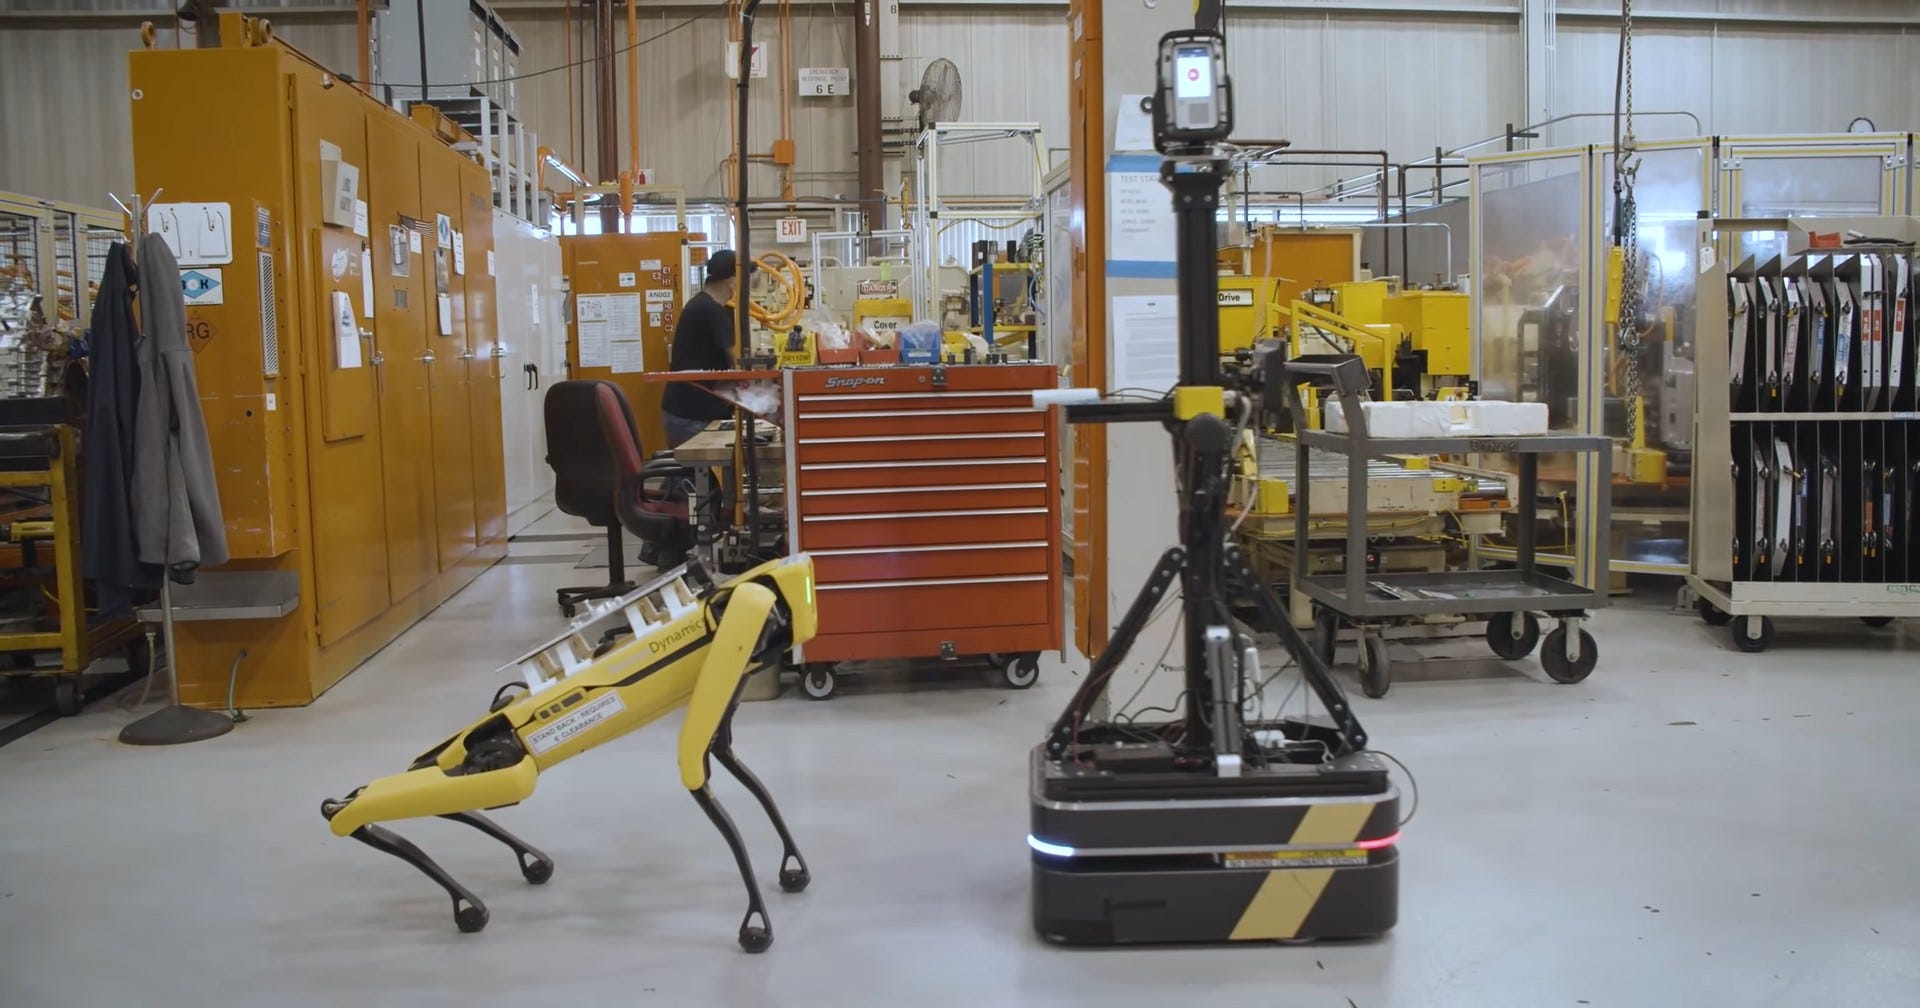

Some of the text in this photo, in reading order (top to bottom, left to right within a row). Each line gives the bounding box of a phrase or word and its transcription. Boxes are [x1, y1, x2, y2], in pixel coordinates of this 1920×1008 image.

[816, 84, 834, 94] 6 E
[1120, 175, 1138, 183] TEST
[782, 221, 802, 236] EXIT
[862, 283, 893, 293] DANGER
[1218, 292, 1241, 302] Drive
[874, 320, 897, 329] Cover
[825, 377, 885, 388] Snap-on
[532, 726, 556, 744] STAND
[556, 717, 575, 732] BACK
